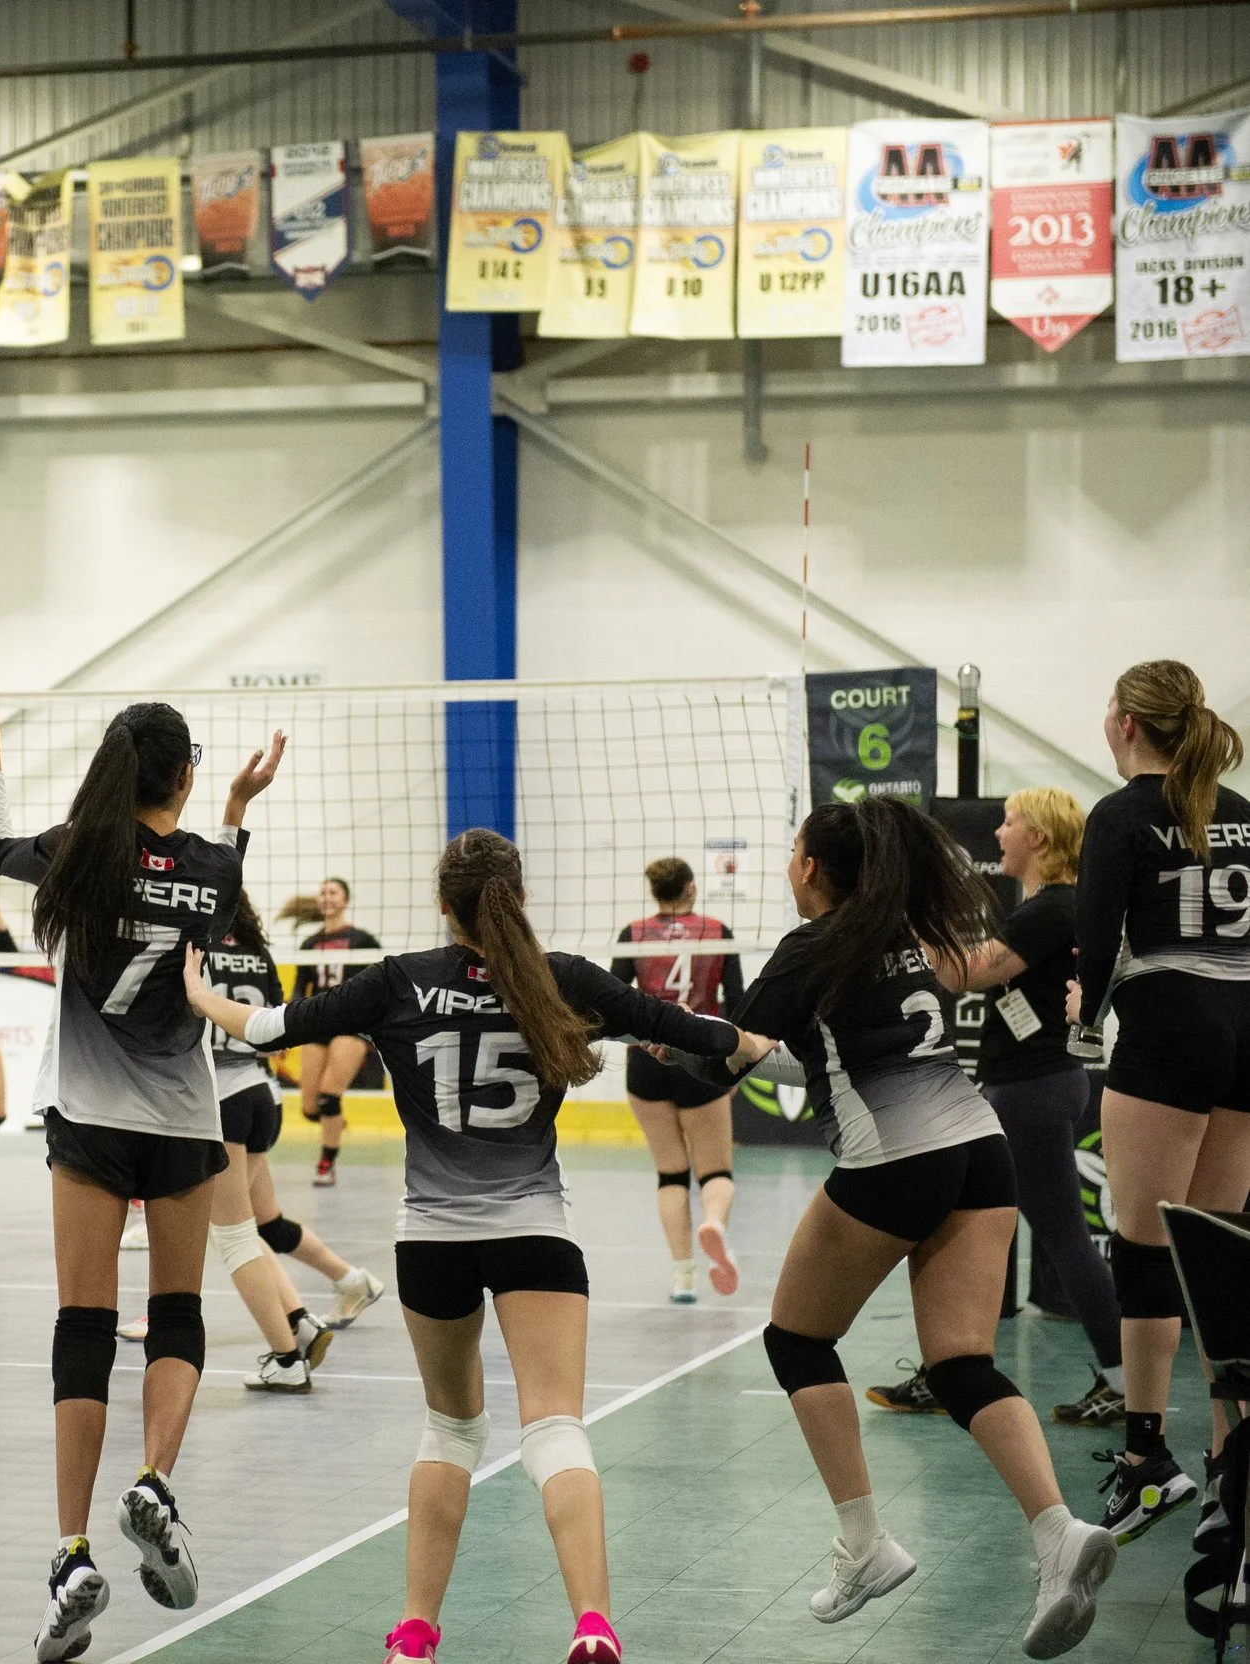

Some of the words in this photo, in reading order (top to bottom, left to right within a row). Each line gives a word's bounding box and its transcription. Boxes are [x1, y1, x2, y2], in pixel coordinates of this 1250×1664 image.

[849, 209, 982, 252] Champions
[1009, 212, 1095, 248] 2013
[1135, 259, 1177, 273] JACKS
[1183, 256, 1245, 271] DIVISION
[861, 270, 967, 298] U16AA
[830, 685, 911, 710] COURT
[857, 723, 893, 771] 6
[868, 780, 922, 796] ONTARIO
[1150, 823, 1250, 851] VIER
[133, 878, 218, 915] ERS
[1158, 864, 1250, 938] 19
[100, 917, 183, 1015] 7
[664, 954, 694, 1004] 4
[411, 980, 510, 1015] VIPE
[900, 990, 954, 1058] 2
[415, 1031, 541, 1132] 15
